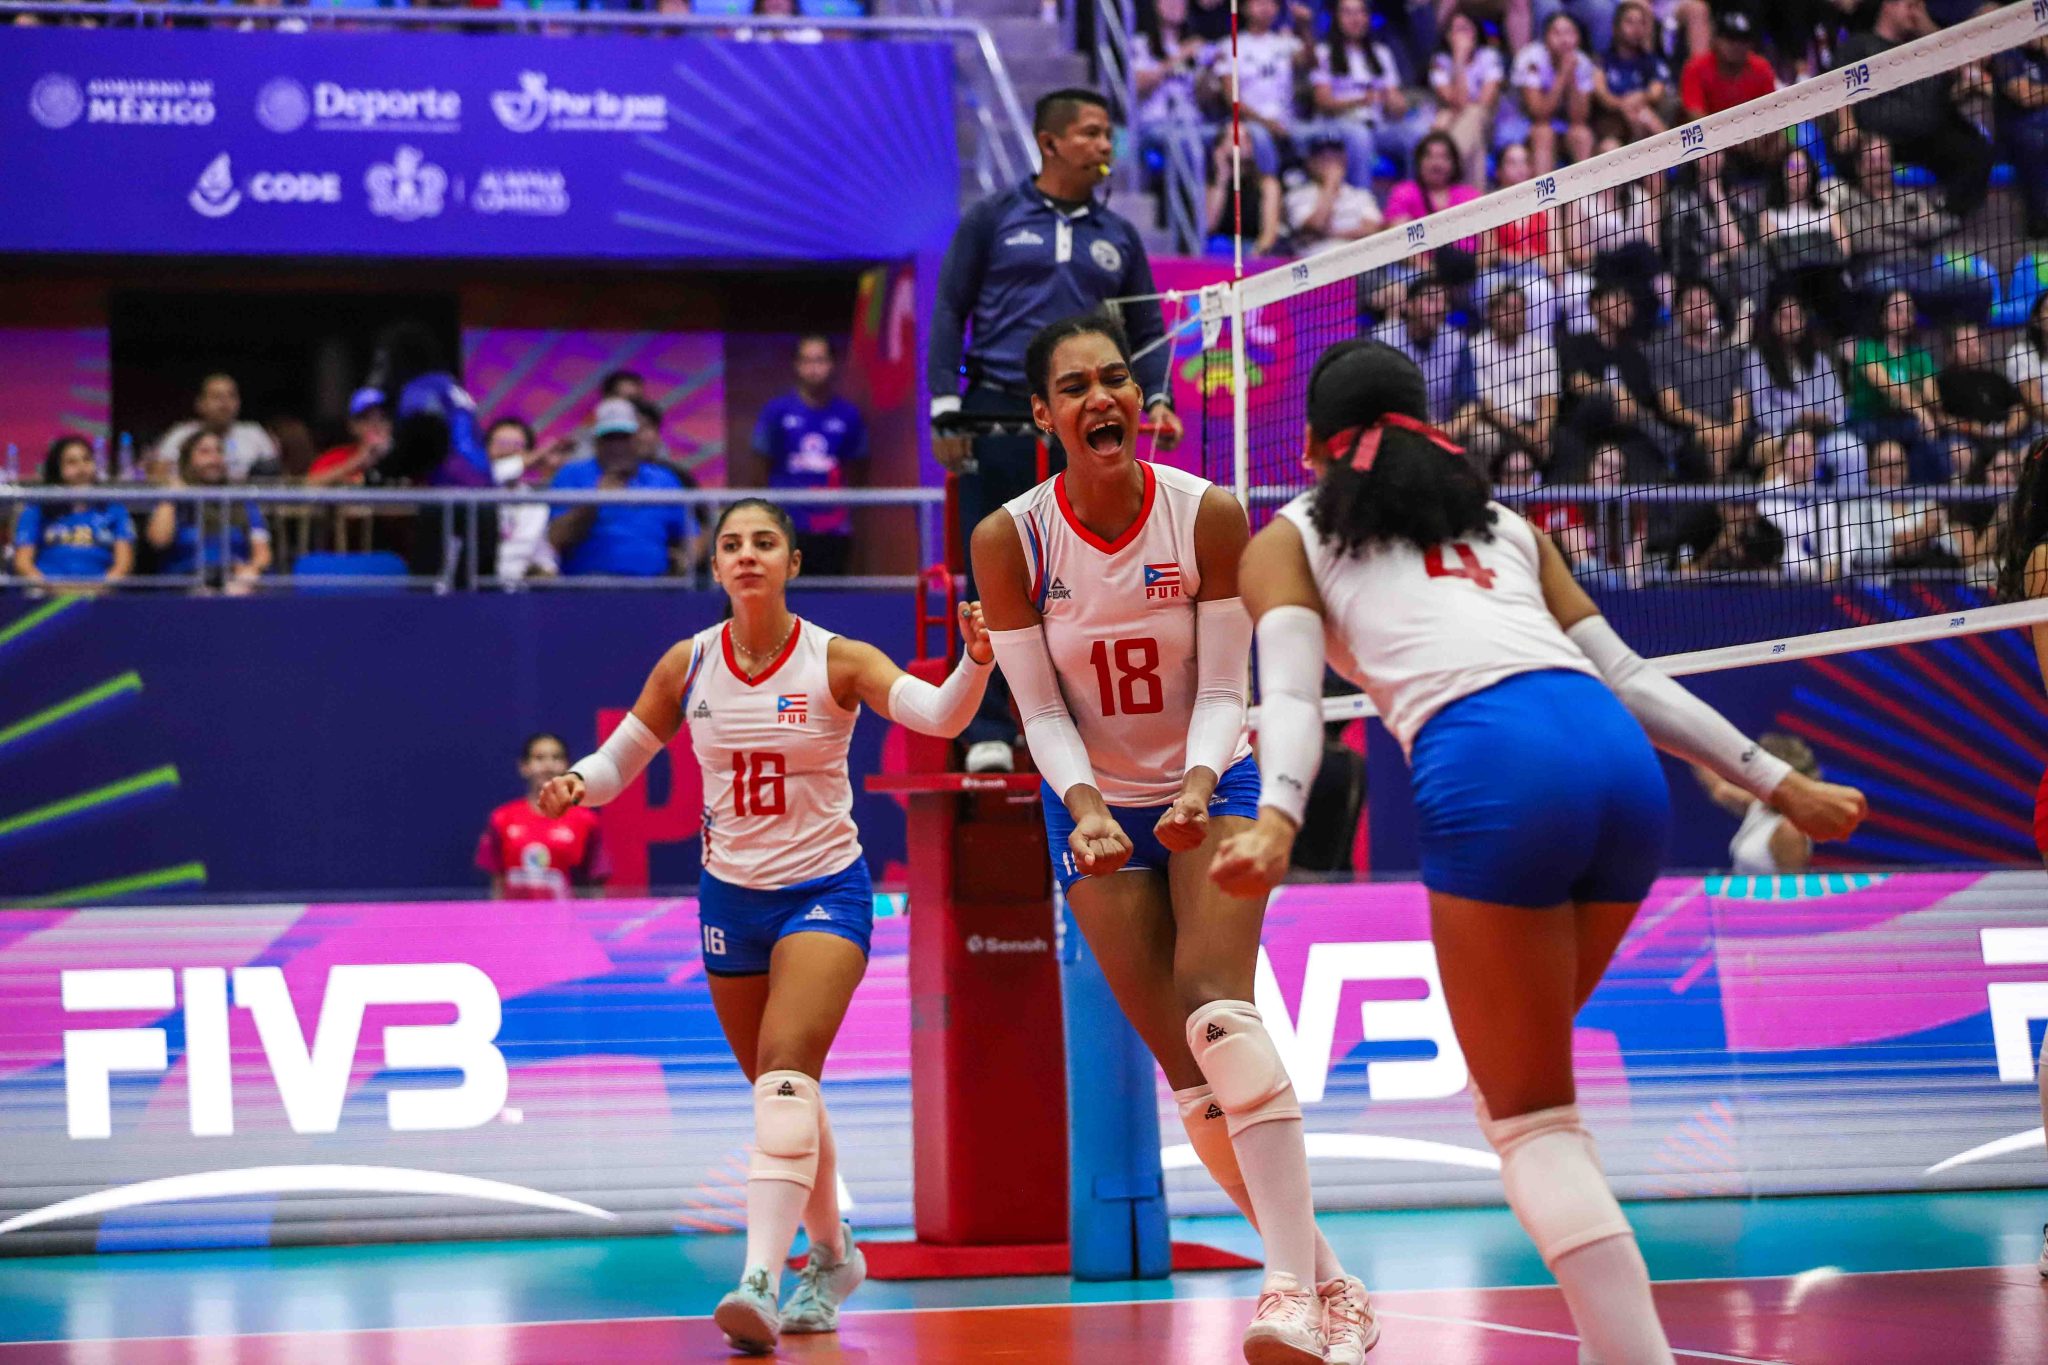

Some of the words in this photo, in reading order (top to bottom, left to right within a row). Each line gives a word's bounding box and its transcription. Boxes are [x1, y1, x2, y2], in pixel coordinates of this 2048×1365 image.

[1844, 64, 1870, 89] FIVB
[314, 82, 462, 126] Deporte
[1681, 124, 1704, 148] FIVB
[250, 172, 342, 202] CODE
[1535, 176, 1556, 198] FIVB
[1407, 223, 1425, 243] FIVB
[1423, 542, 1498, 590] 4
[1047, 589, 1071, 599] PEAK
[1146, 586, 1180, 600] PUR
[1090, 637, 1164, 717] 18
[777, 714, 807, 724] PUR
[703, 924, 727, 955] 16
[984, 937, 1048, 953] Senoh
[1206, 1028, 1227, 1042] PEAK
[61, 962, 509, 1139] FIVB
